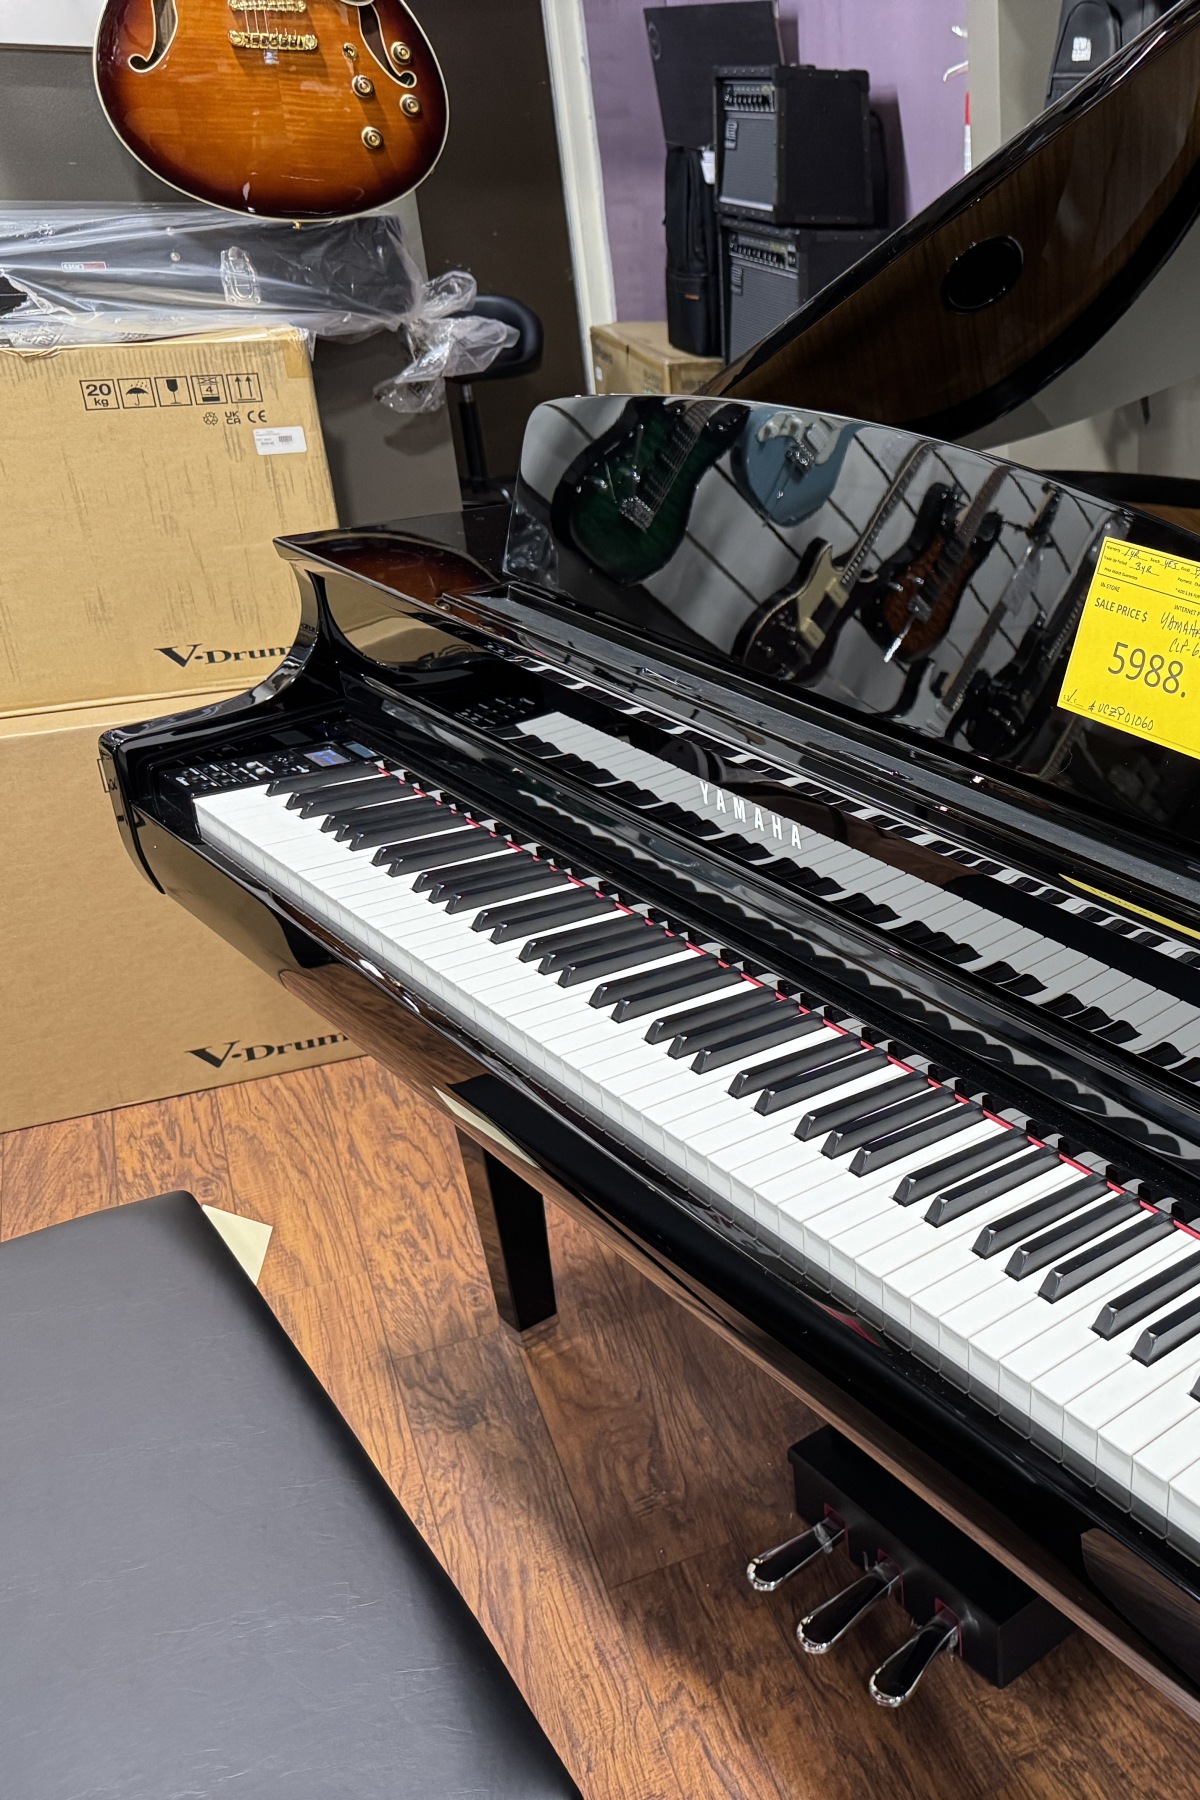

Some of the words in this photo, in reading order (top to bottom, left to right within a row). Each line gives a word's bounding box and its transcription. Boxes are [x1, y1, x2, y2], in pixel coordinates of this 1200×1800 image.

[85, 383, 113, 398] 20
[205, 385, 214, 394] 4
[94, 396, 109, 407] kg
[1094, 597, 1116, 612] SALE
[1116, 604, 1141, 620] PRICE
[1141, 611, 1149, 623] $
[1173, 604, 1197, 616] INTERNET
[699, 780, 803, 850] YAMAHA
